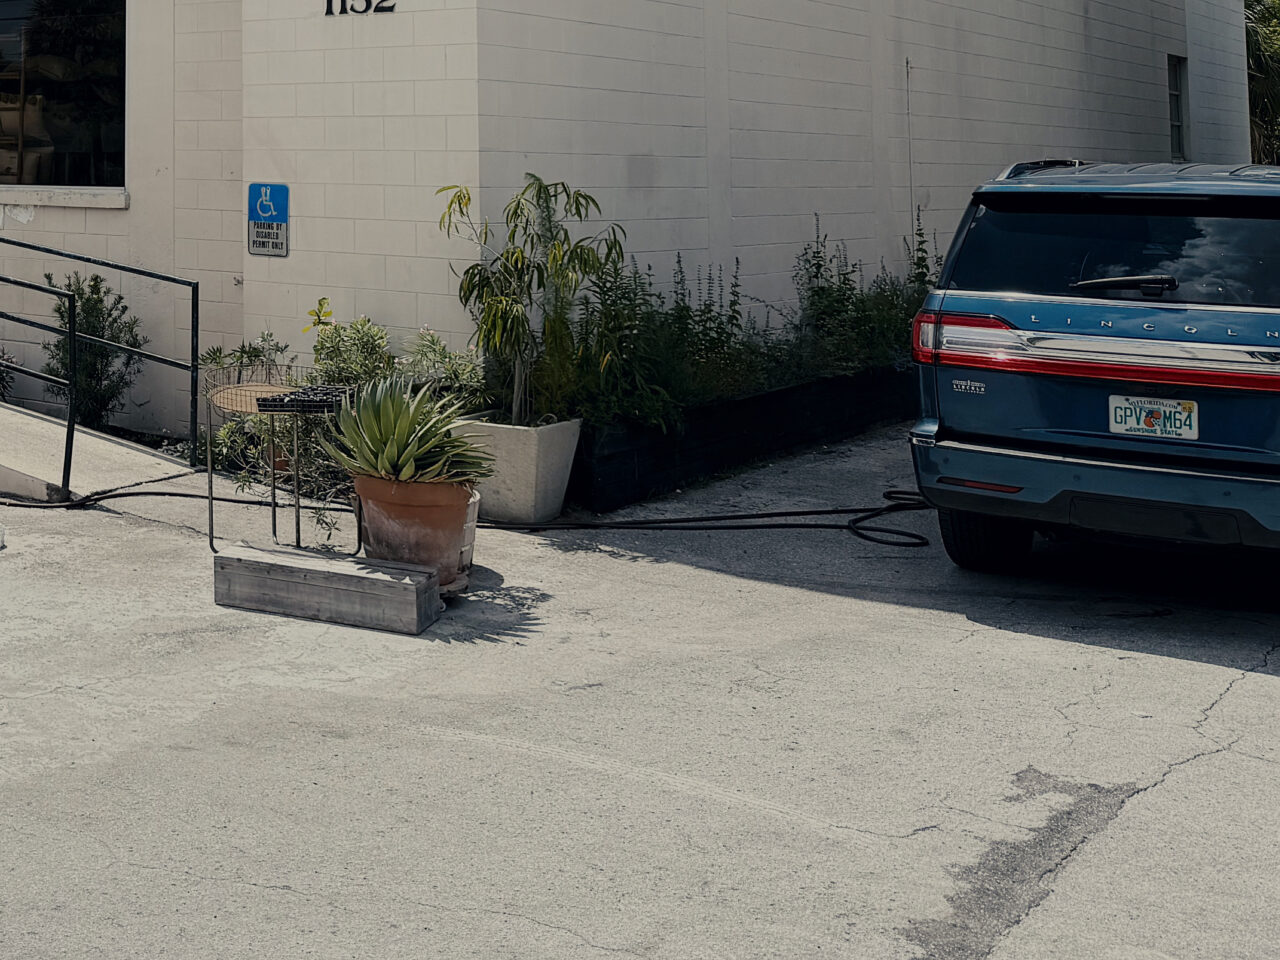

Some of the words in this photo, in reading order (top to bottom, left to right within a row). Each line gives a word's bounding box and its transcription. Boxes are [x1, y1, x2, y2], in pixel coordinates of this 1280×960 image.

[253, 221, 274, 230] PARKING
[275, 223, 283, 231] BY
[256, 230, 279, 240] DISABLED
[252, 240, 270, 249] PERMIT
[271, 241, 284, 250] ONLY
[1031, 314, 1280, 339] LINCOLN
[1114, 406, 1143, 426] GPV
[1162, 410, 1193, 431] M64
